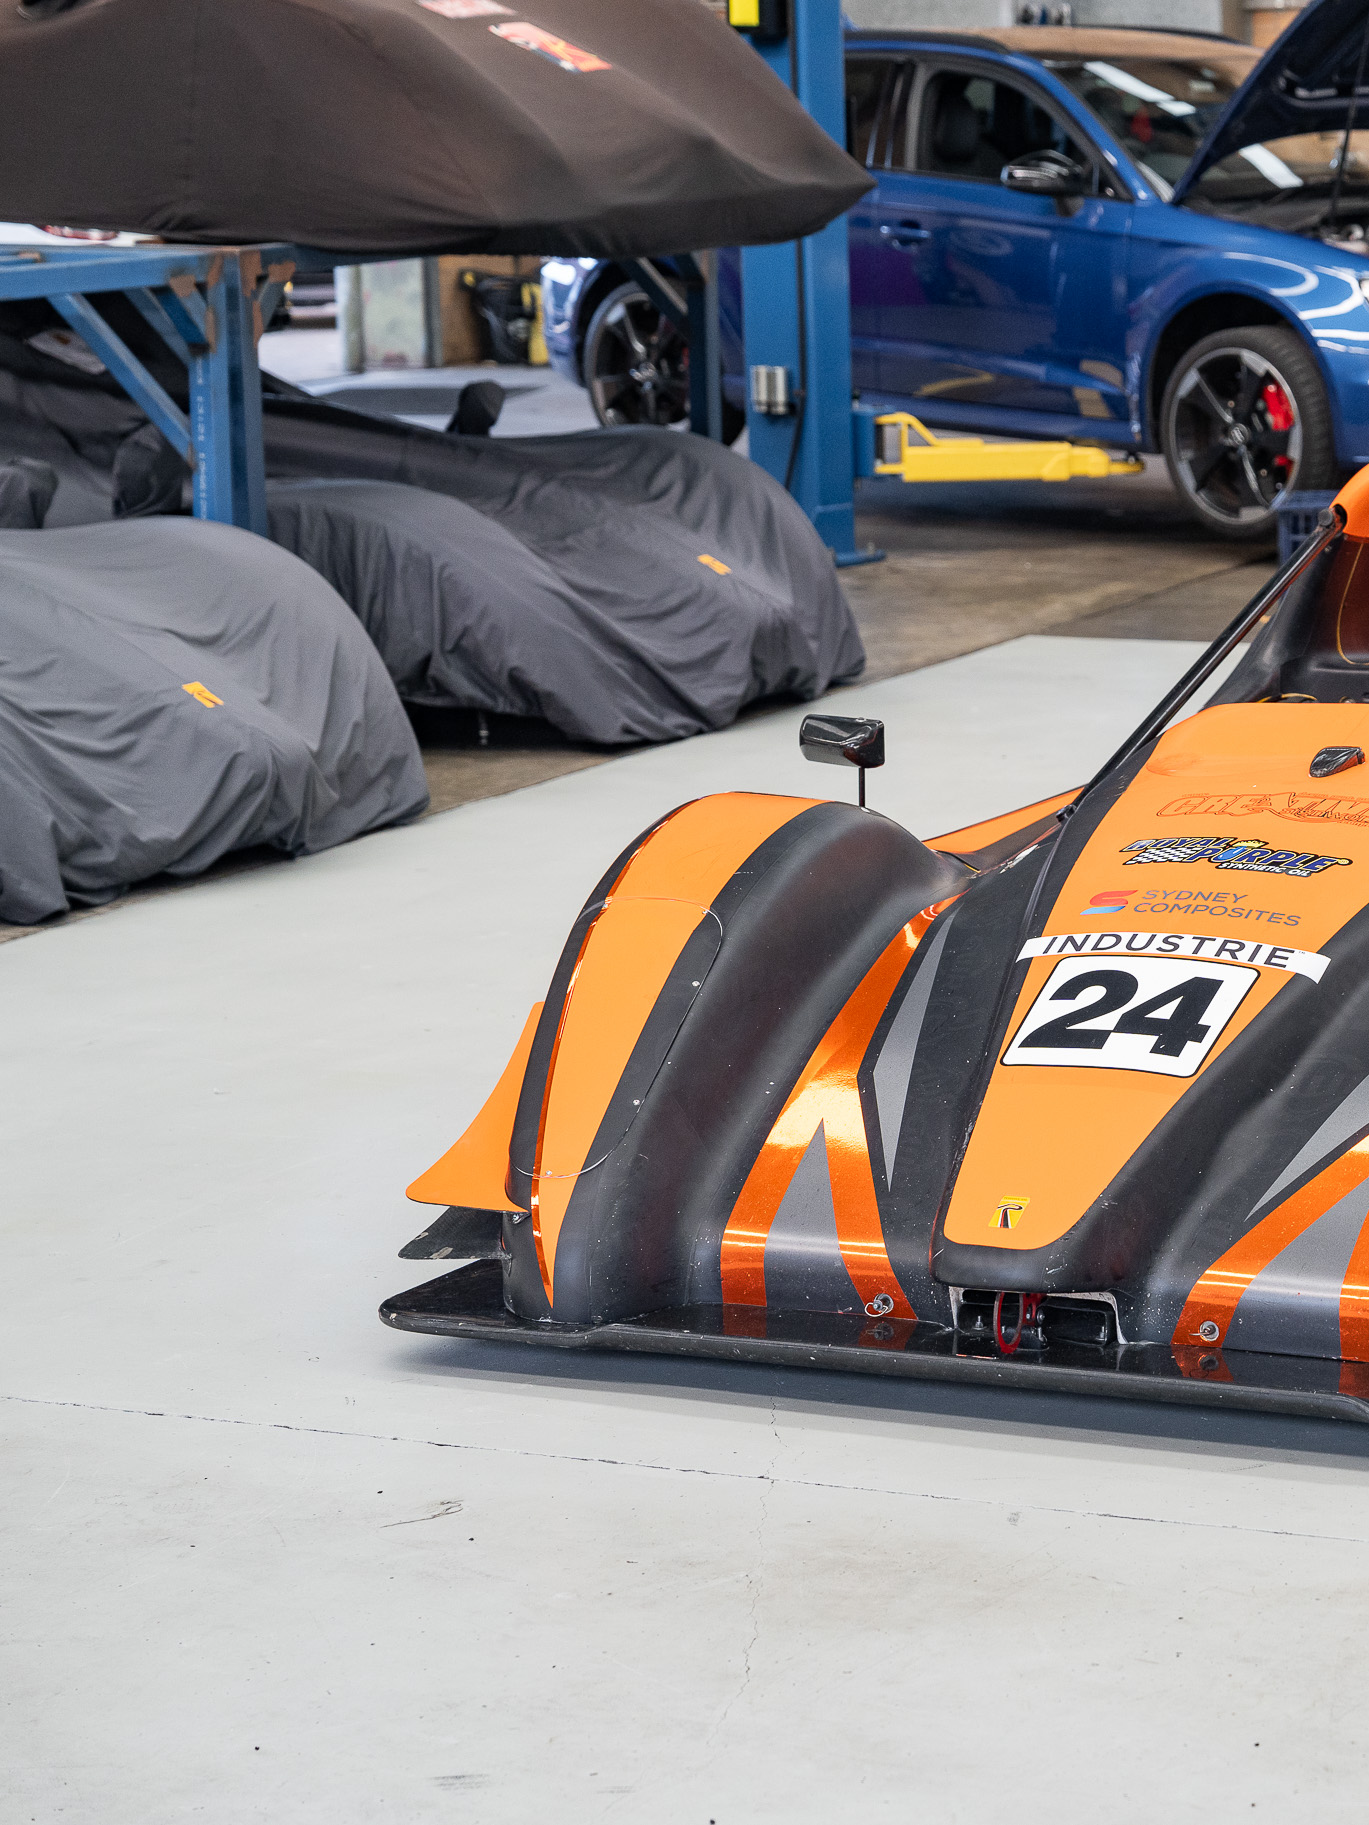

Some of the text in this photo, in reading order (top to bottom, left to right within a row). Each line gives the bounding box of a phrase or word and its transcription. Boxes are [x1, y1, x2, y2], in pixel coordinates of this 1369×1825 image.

[1119, 837, 1237, 852] ROYAL
[1183, 845, 1340, 873] PURPLE
[1217, 862, 1312, 877] SYNTHETIC OIL
[1142, 890, 1248, 904] SYDNEY
[1133, 902, 1301, 926] COMPOSITES
[1042, 933, 1295, 968] INDUSTRIE
[1018, 969, 1224, 1057] 24
